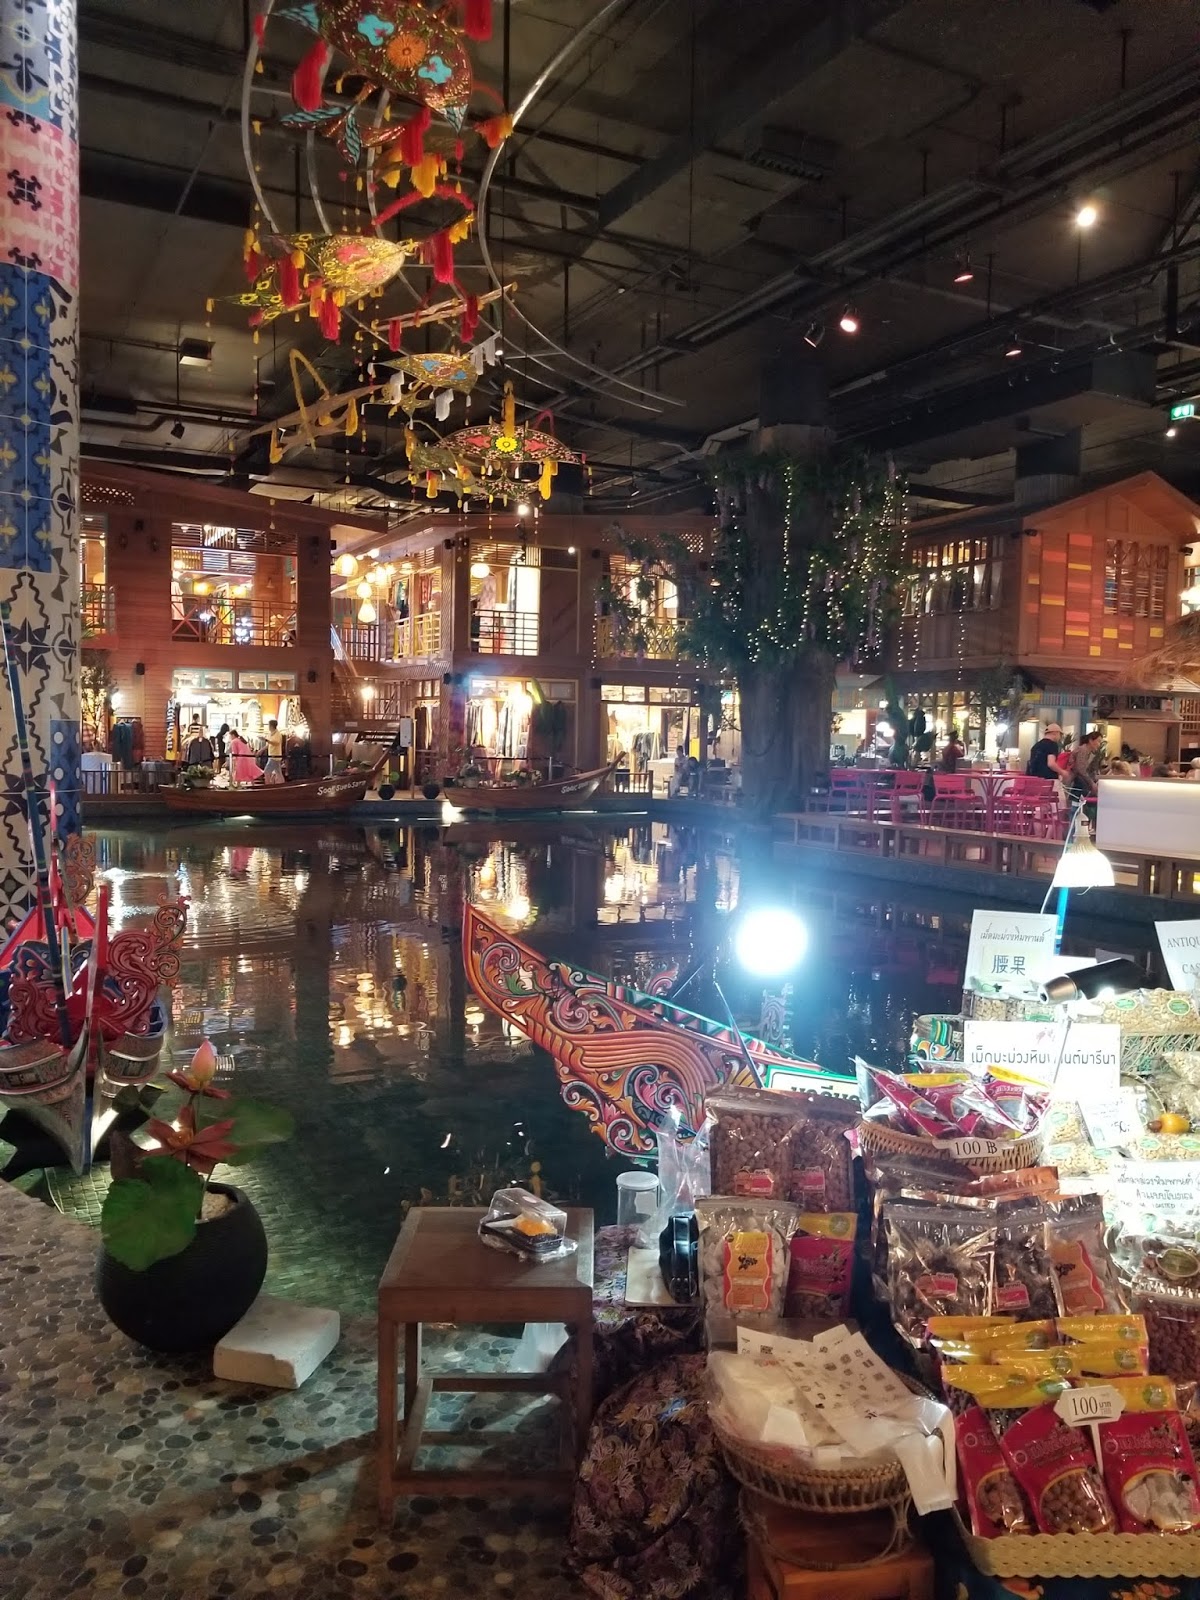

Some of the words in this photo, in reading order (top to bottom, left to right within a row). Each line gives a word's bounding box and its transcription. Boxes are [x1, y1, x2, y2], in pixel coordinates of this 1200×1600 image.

[991, 954, 1026, 976] 腰果
[955, 1140, 981, 1156] 100
[1072, 1396, 1098, 1416] 100
